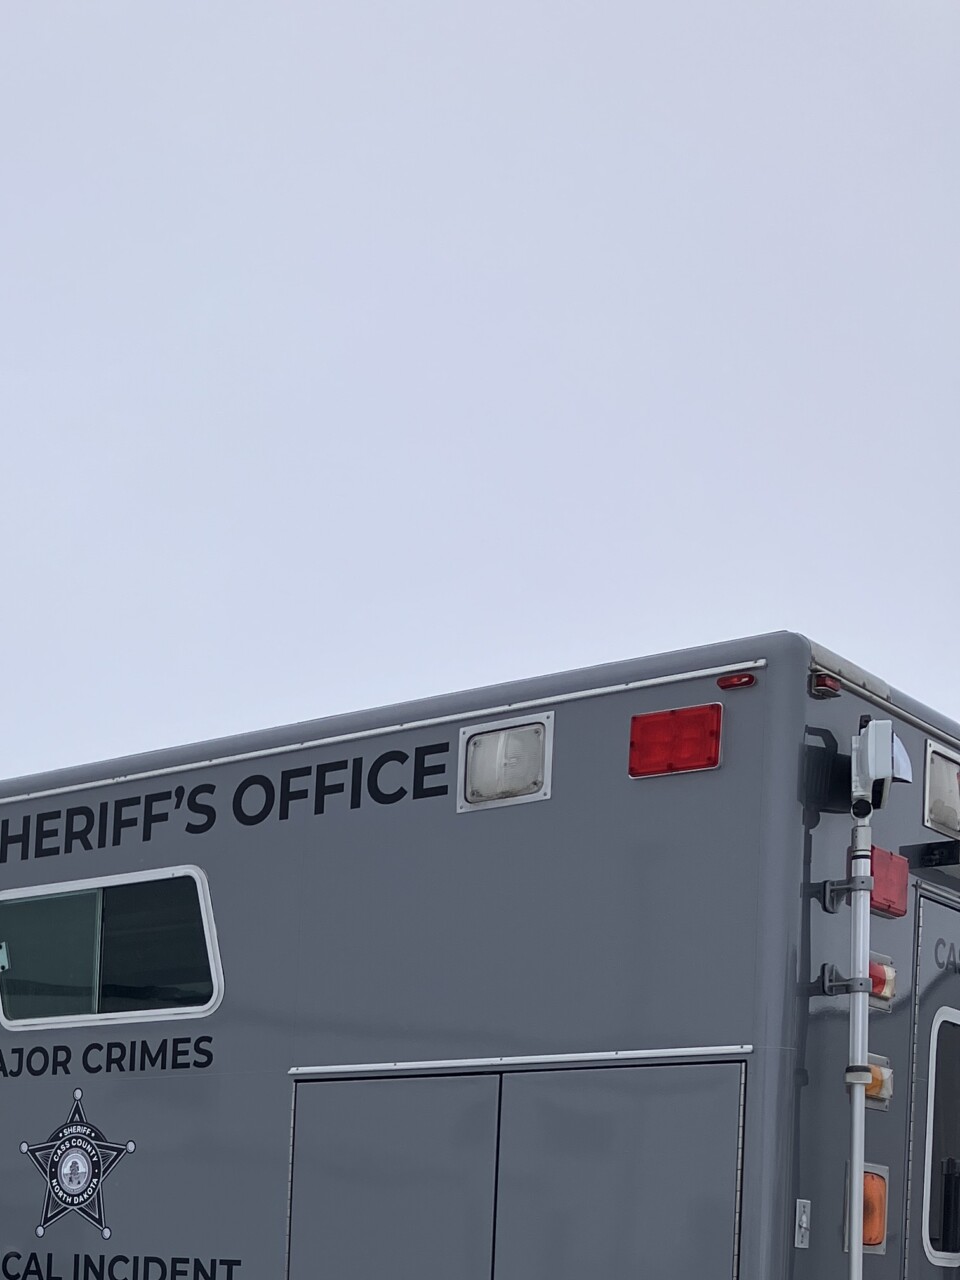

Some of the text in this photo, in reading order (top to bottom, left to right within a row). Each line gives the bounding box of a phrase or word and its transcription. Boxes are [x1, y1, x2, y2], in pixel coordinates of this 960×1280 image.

[232, 742, 450, 826] OFFICE
[935, 938, 960, 974] CA
[82, 1036, 214, 1074] CRIMES
[63, 1126, 91, 1136] SHERIFF
[53, 1139, 98, 1161] CASS COUNTY
[51, 1178, 98, 1204] NORTH DAKOTA
